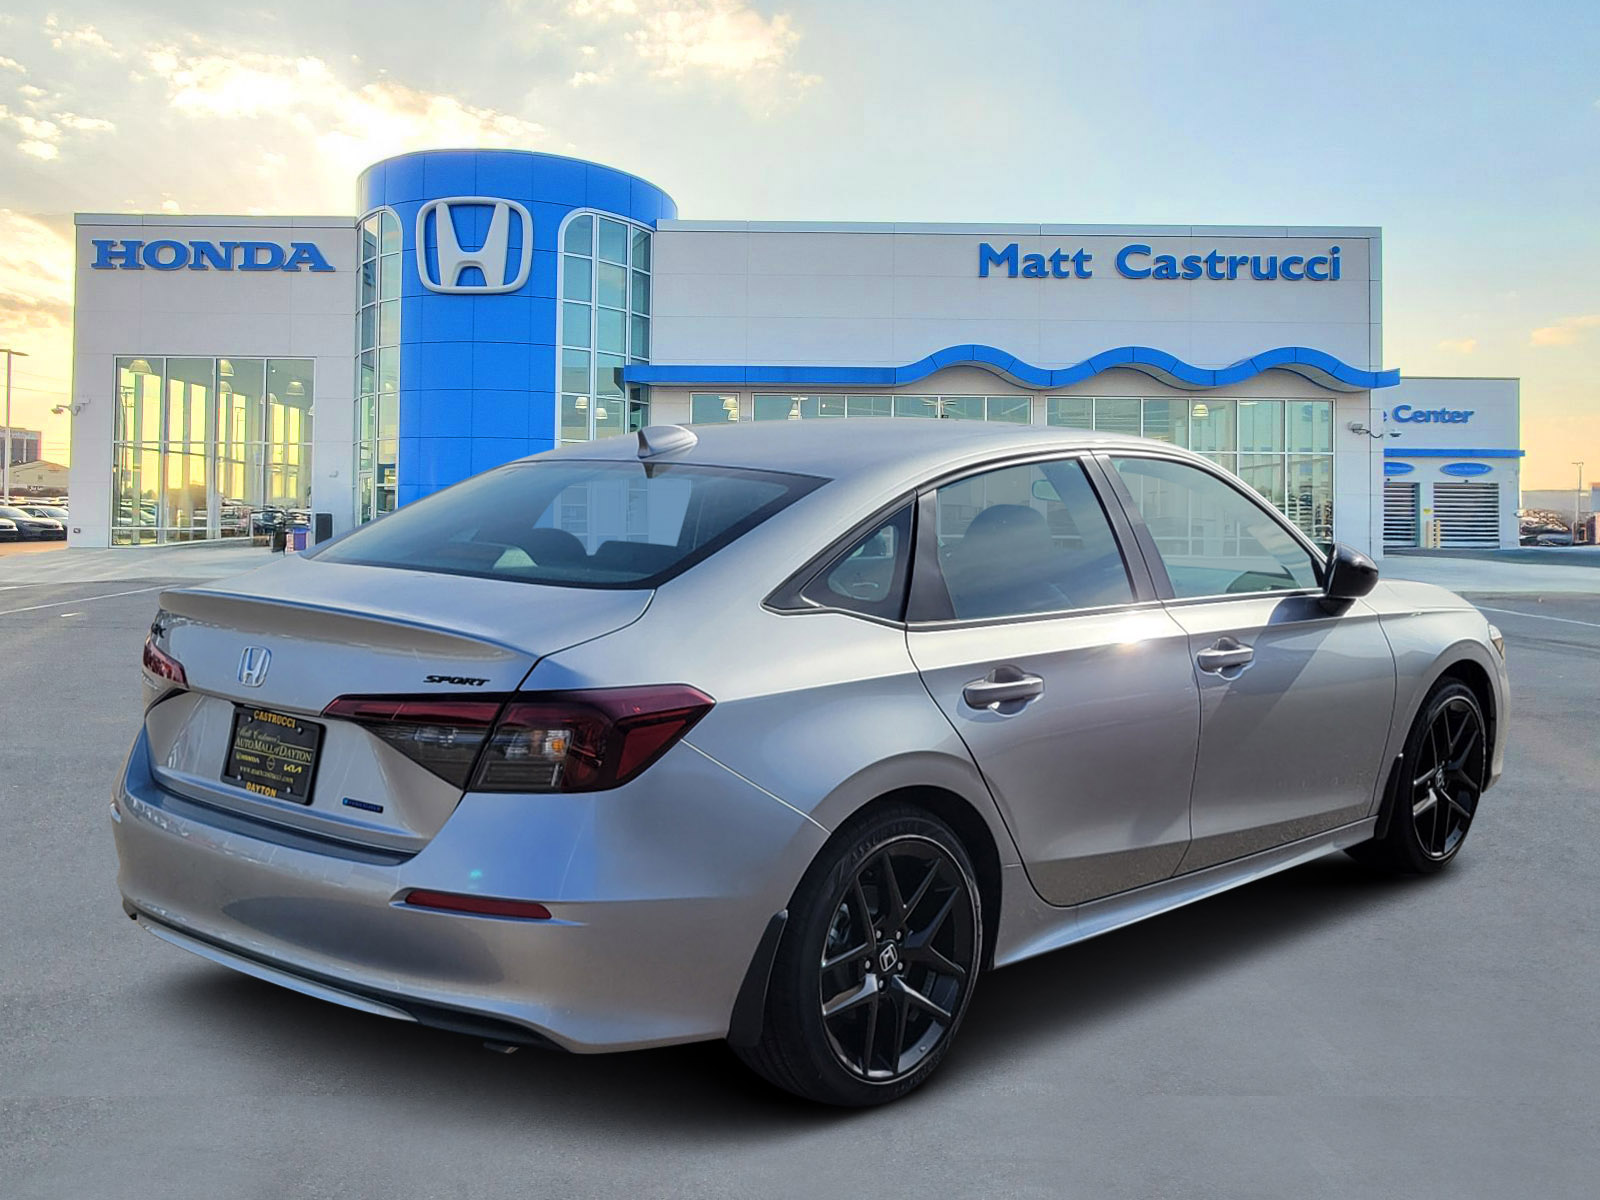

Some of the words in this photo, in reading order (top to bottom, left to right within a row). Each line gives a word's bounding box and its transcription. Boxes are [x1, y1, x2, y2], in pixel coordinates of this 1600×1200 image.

[91, 240, 335, 272] HONDA
[978, 242, 1093, 279] Matt
[1115, 243, 1342, 281] Castrucci
[1392, 404, 1475, 424] Center
[423, 675, 491, 686] SPORT
[253, 710, 296, 728] CASTRUCCI
[246, 782, 278, 798] DAYTON
